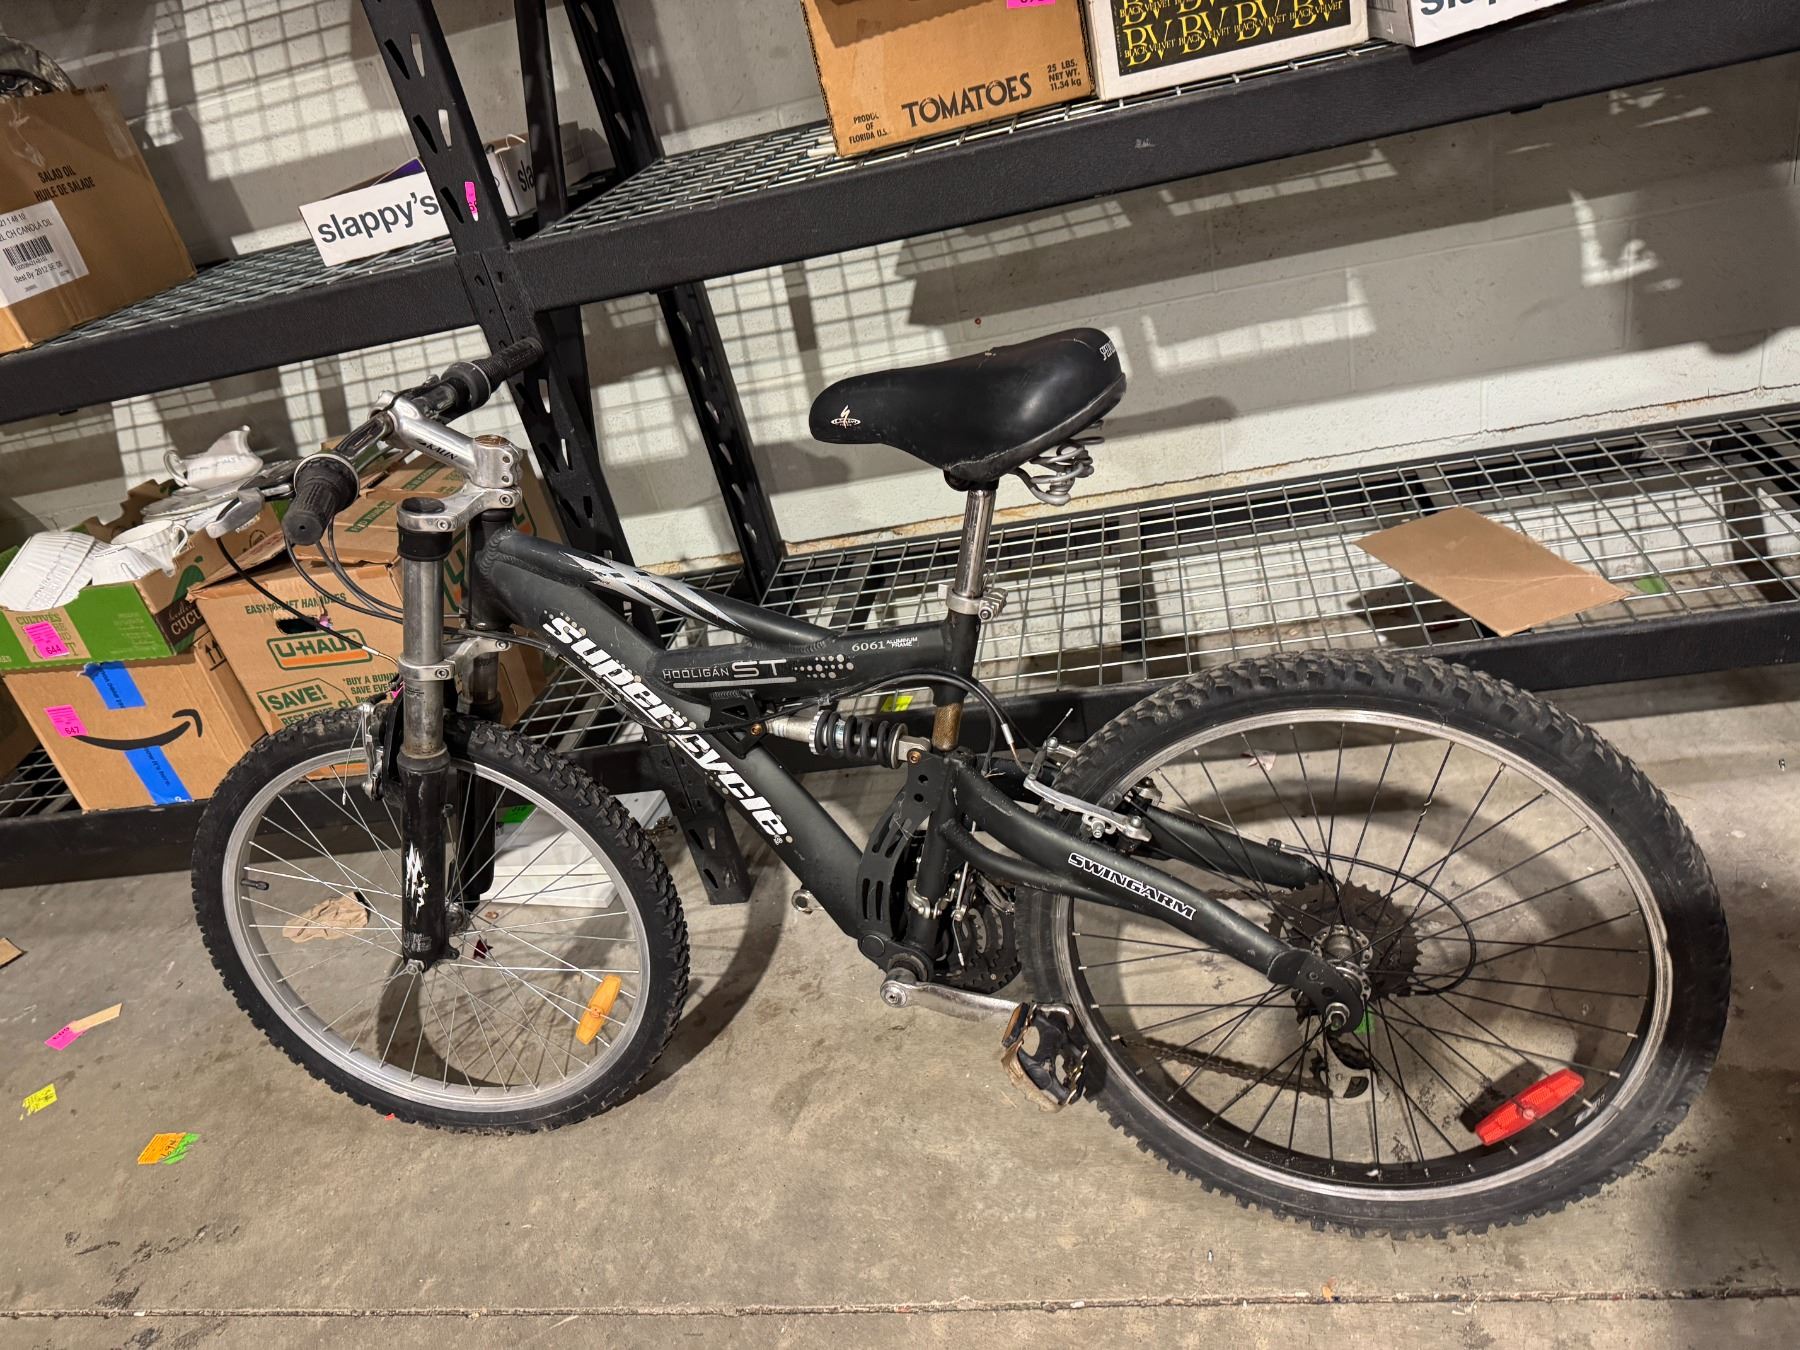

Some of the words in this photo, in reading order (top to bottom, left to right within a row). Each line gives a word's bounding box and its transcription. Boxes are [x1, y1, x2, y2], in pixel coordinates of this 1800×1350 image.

[1123, 20, 1173, 67] BV
[1178, 6, 1229, 54] BV
[1124, 44, 1148, 58] BLACK
[1149, 39, 1175, 53] VELVET
[1178, 33, 1203, 46] BLACK
[1203, 26, 1231, 40] VELVET
[1233, 20, 1258, 33] BLACK
[1259, 13, 1287, 27] VELVET
[1289, 7, 1314, 21] BLACK
[1315, 1, 1343, 13] VELVET
[1047, 63, 1057, 73] 25
[1061, 59, 1078, 70] LBS.
[1048, 72, 1064, 82] NET
[1065, 69, 1081, 78] WT.
[1050, 80, 1069, 91] 11.34
[1071, 78, 1082, 87] kg
[901, 72, 1032, 127] TOMATOES
[865, 122, 873, 131] OF
[848, 131, 875, 144] FLORIDA
[38, 168, 64, 183] SALAD
[62, 165, 77, 177] OIL
[33, 186, 58, 202] HUILE
[56, 183, 69, 196] DE
[67, 176, 96, 193] SALADE
[317, 191, 439, 244] slappy's
[171, 609, 203, 635] CUCU
[851, 640, 886, 652] 6061
[891, 641, 913, 649] FRAME
[731, 658, 787, 678] ST
[364, 676, 371, 685] A
[372, 672, 398, 683] BUND
[266, 684, 328, 711] SAVE!
[350, 685, 371, 695] SAVE
[65, 726, 80, 735] 647
[1067, 852, 1197, 920] SWINGARM
